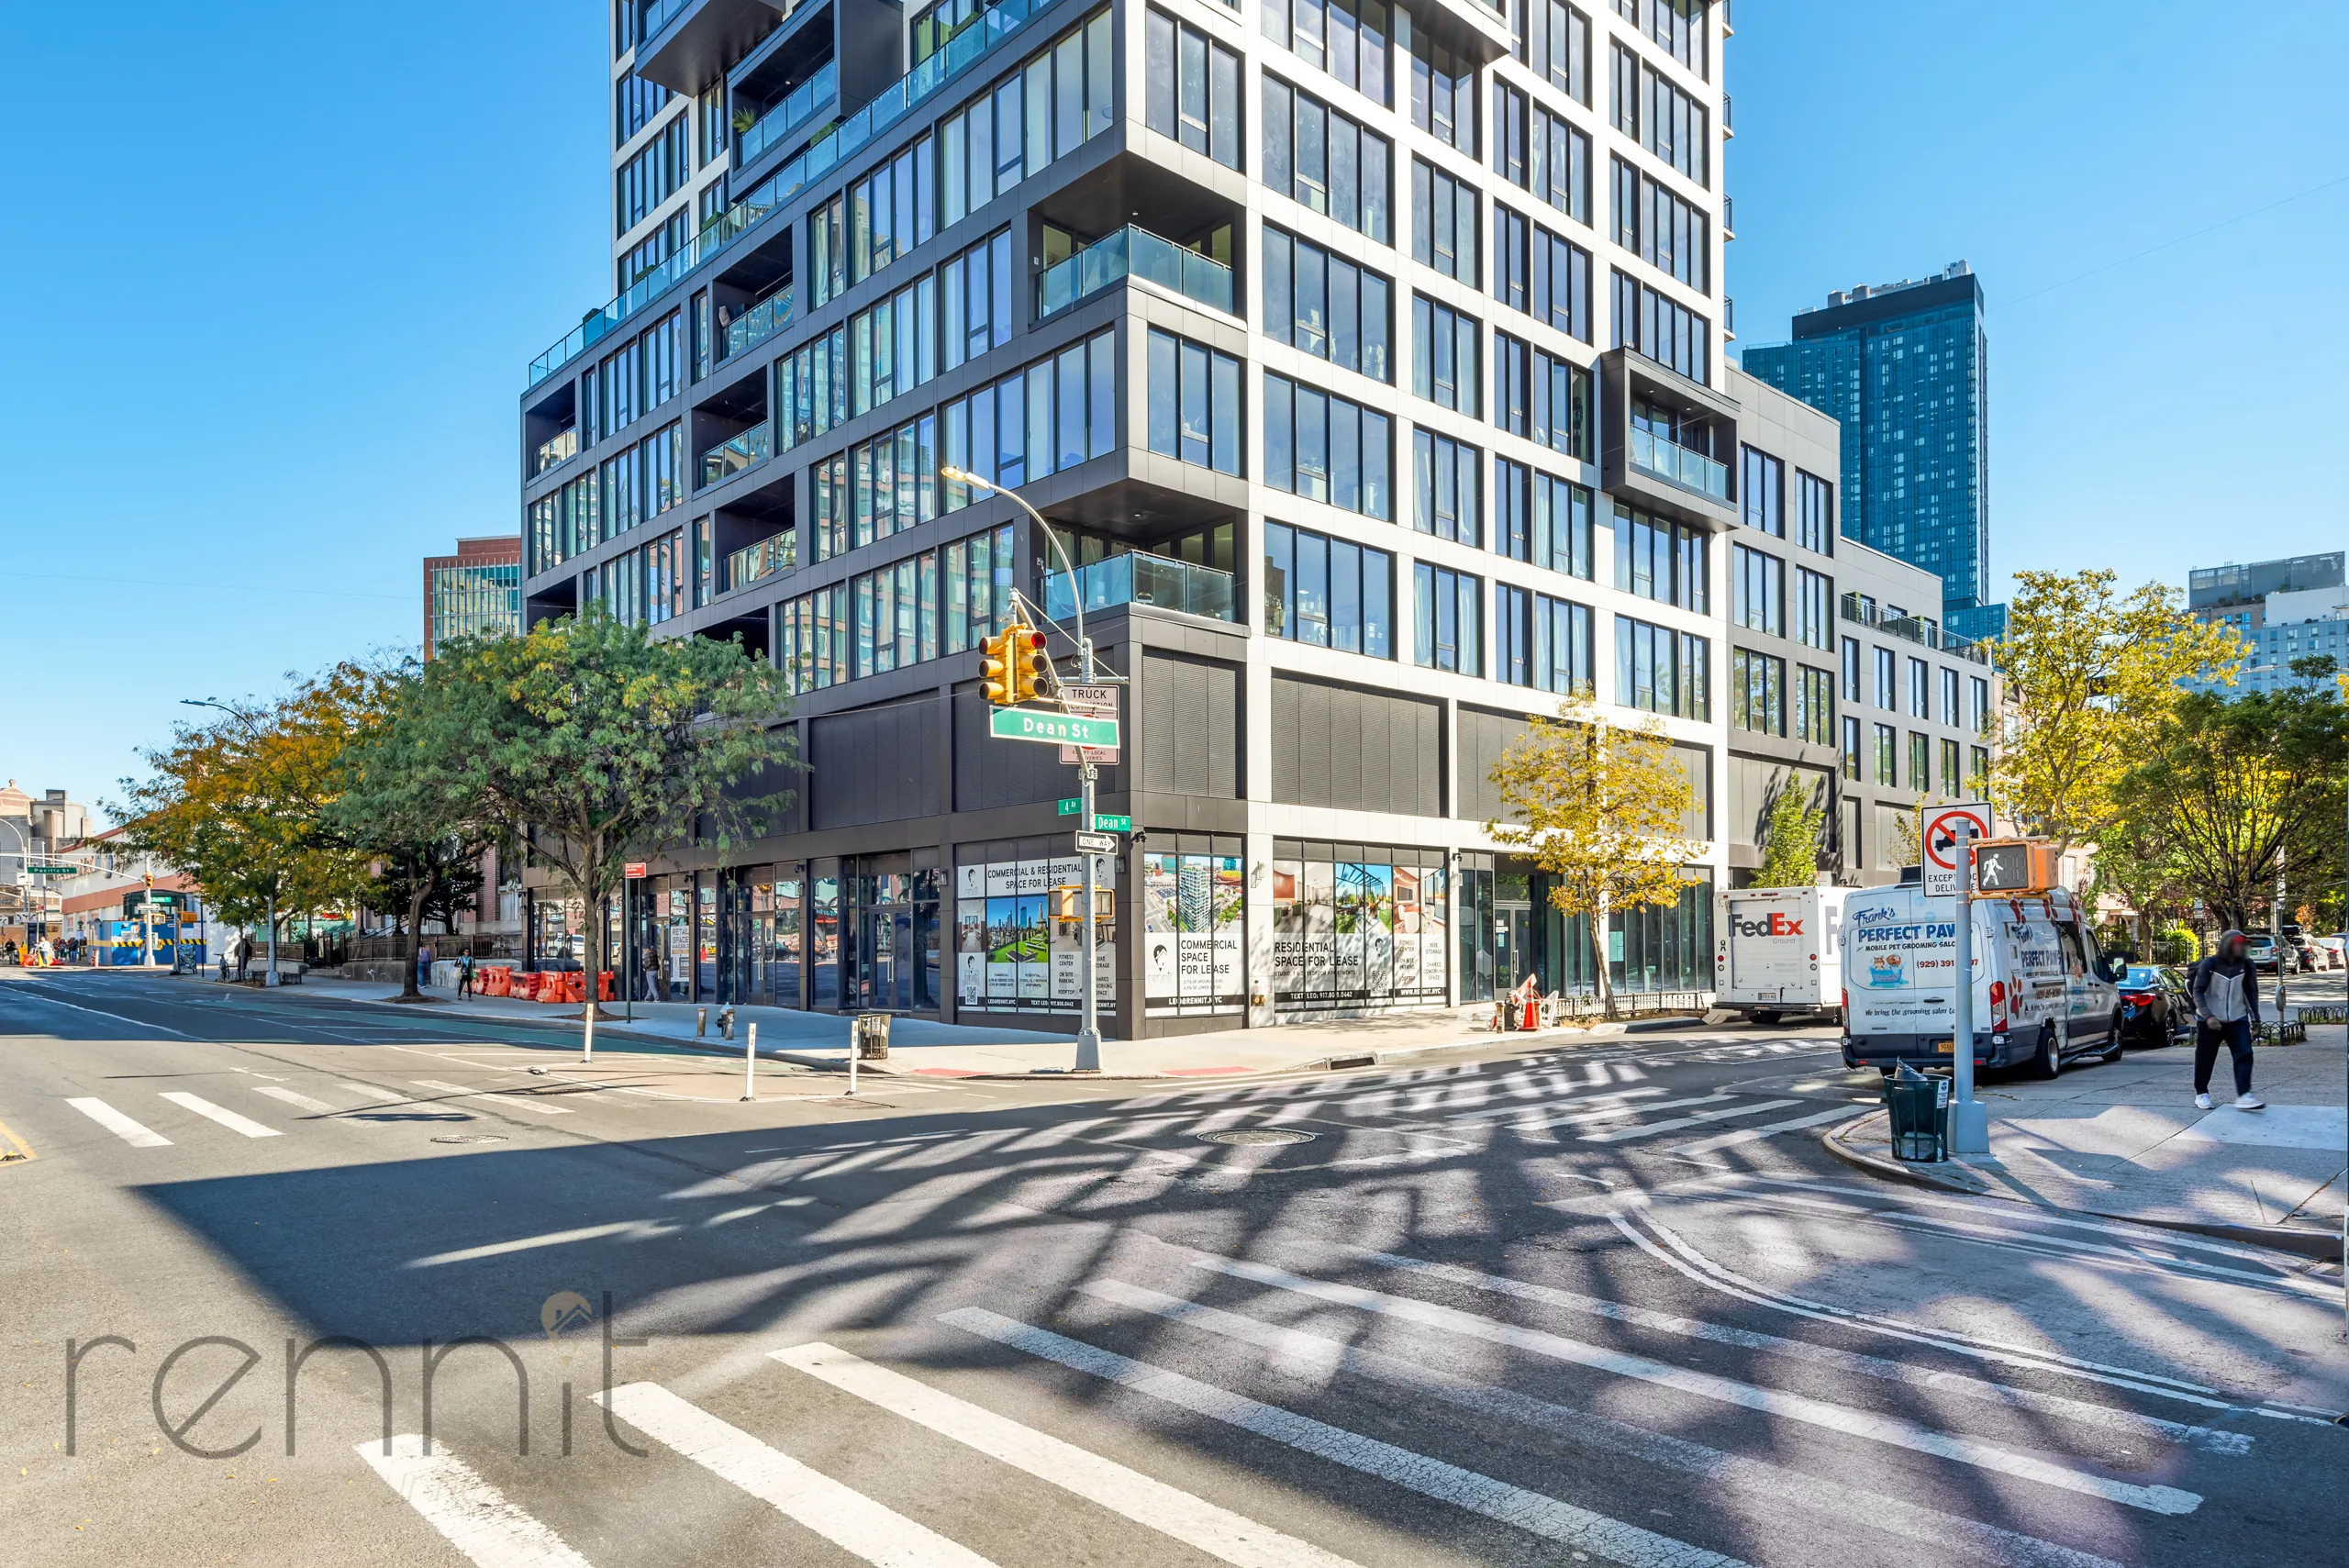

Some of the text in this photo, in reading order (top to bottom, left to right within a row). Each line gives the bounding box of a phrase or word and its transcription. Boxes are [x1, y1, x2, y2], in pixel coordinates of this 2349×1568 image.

[1072, 689, 1107, 699] TRUCK
[1024, 717, 1088, 739] Dean St
[1064, 802, 1069, 813] 4
[1098, 817, 1118, 828] Dean
[987, 864, 1083, 879] COMMERCIAL & RESIDENTIAL
[1006, 877, 1066, 890] SPACE FOR LEASE
[1853, 906, 1896, 928] Frank's
[1728, 912, 1804, 937] FedEx
[1858, 925, 1921, 943] PERFECT
[1181, 940, 1237, 949] COMMERCIAL
[1275, 942, 1334, 952] RESIDENTIAL
[1902, 941, 1938, 950] GROOMING
[1181, 952, 1208, 962] SPACE
[1275, 956, 1358, 967] SPACE FOR LEASE
[2021, 949, 2061, 968] PERFECT PAWS
[1182, 965, 1230, 974] FOR LEASE
[1916, 960, 1938, 969] (929)
[1148, 973, 1173, 983] rennit
[1903, 1007, 1931, 1017] grooming
